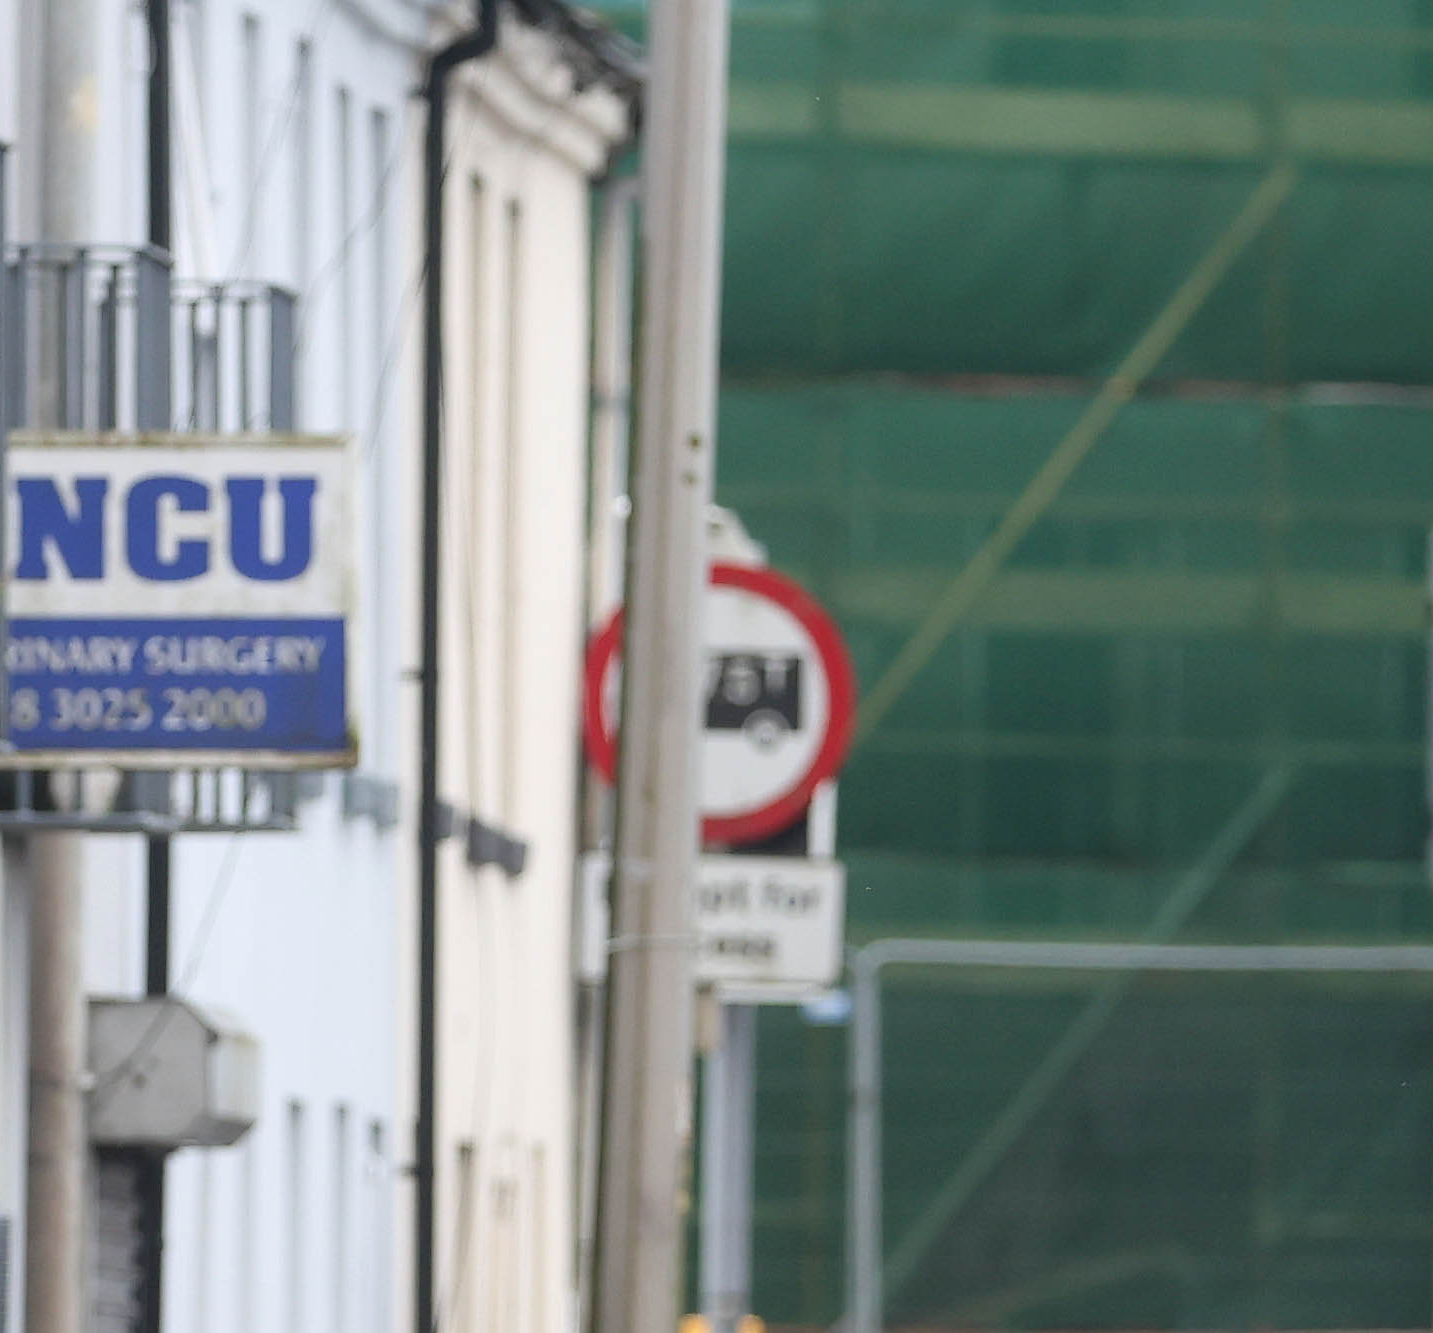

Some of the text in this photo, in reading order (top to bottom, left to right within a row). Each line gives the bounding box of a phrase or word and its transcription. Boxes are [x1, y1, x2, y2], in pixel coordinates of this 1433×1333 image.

[144, 636, 325, 675] SURGERY
[50, 688, 153, 731] 3025
[161, 688, 266, 731] 2000
